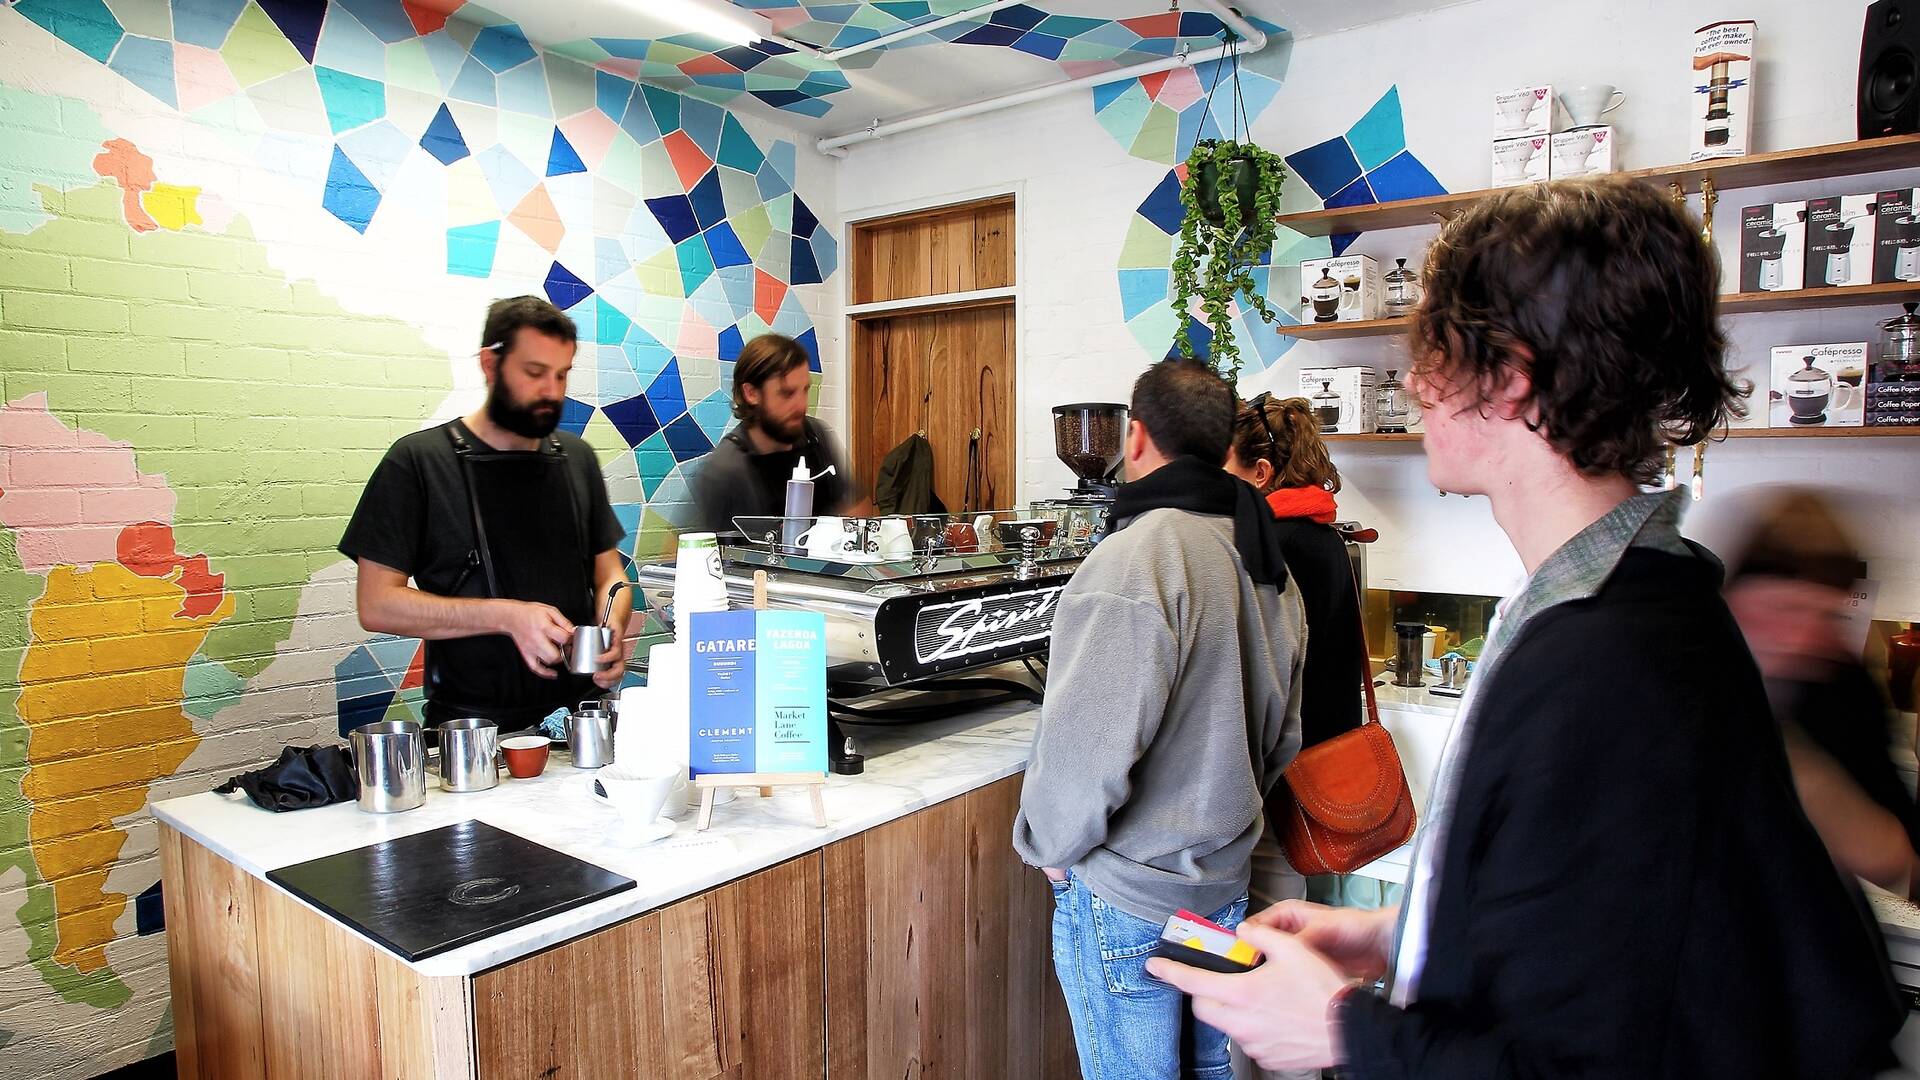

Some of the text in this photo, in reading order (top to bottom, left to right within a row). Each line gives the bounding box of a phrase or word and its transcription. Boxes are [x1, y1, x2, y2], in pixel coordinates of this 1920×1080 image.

[1701, 36, 1721, 45] coffee
[1708, 41, 1722, 49] ever
[1553, 136, 1576, 144] Dripper
[1494, 143, 1515, 152] Dripper
[1881, 203, 1912, 213] ceramic
[1811, 211, 1840, 220] ceramic
[1746, 219, 1773, 227] ceramic
[1811, 347, 1863, 357] Cafépresso
[1877, 400, 1920, 408] Coffee Paper
[926, 589, 1059, 659] Spirit
[696, 639, 756, 653] GATARE
[774, 711, 806, 719] Market
[774, 721, 797, 729] Lane
[698, 727, 753, 737] CLEMENT
[774, 730, 802, 739] Coffee
